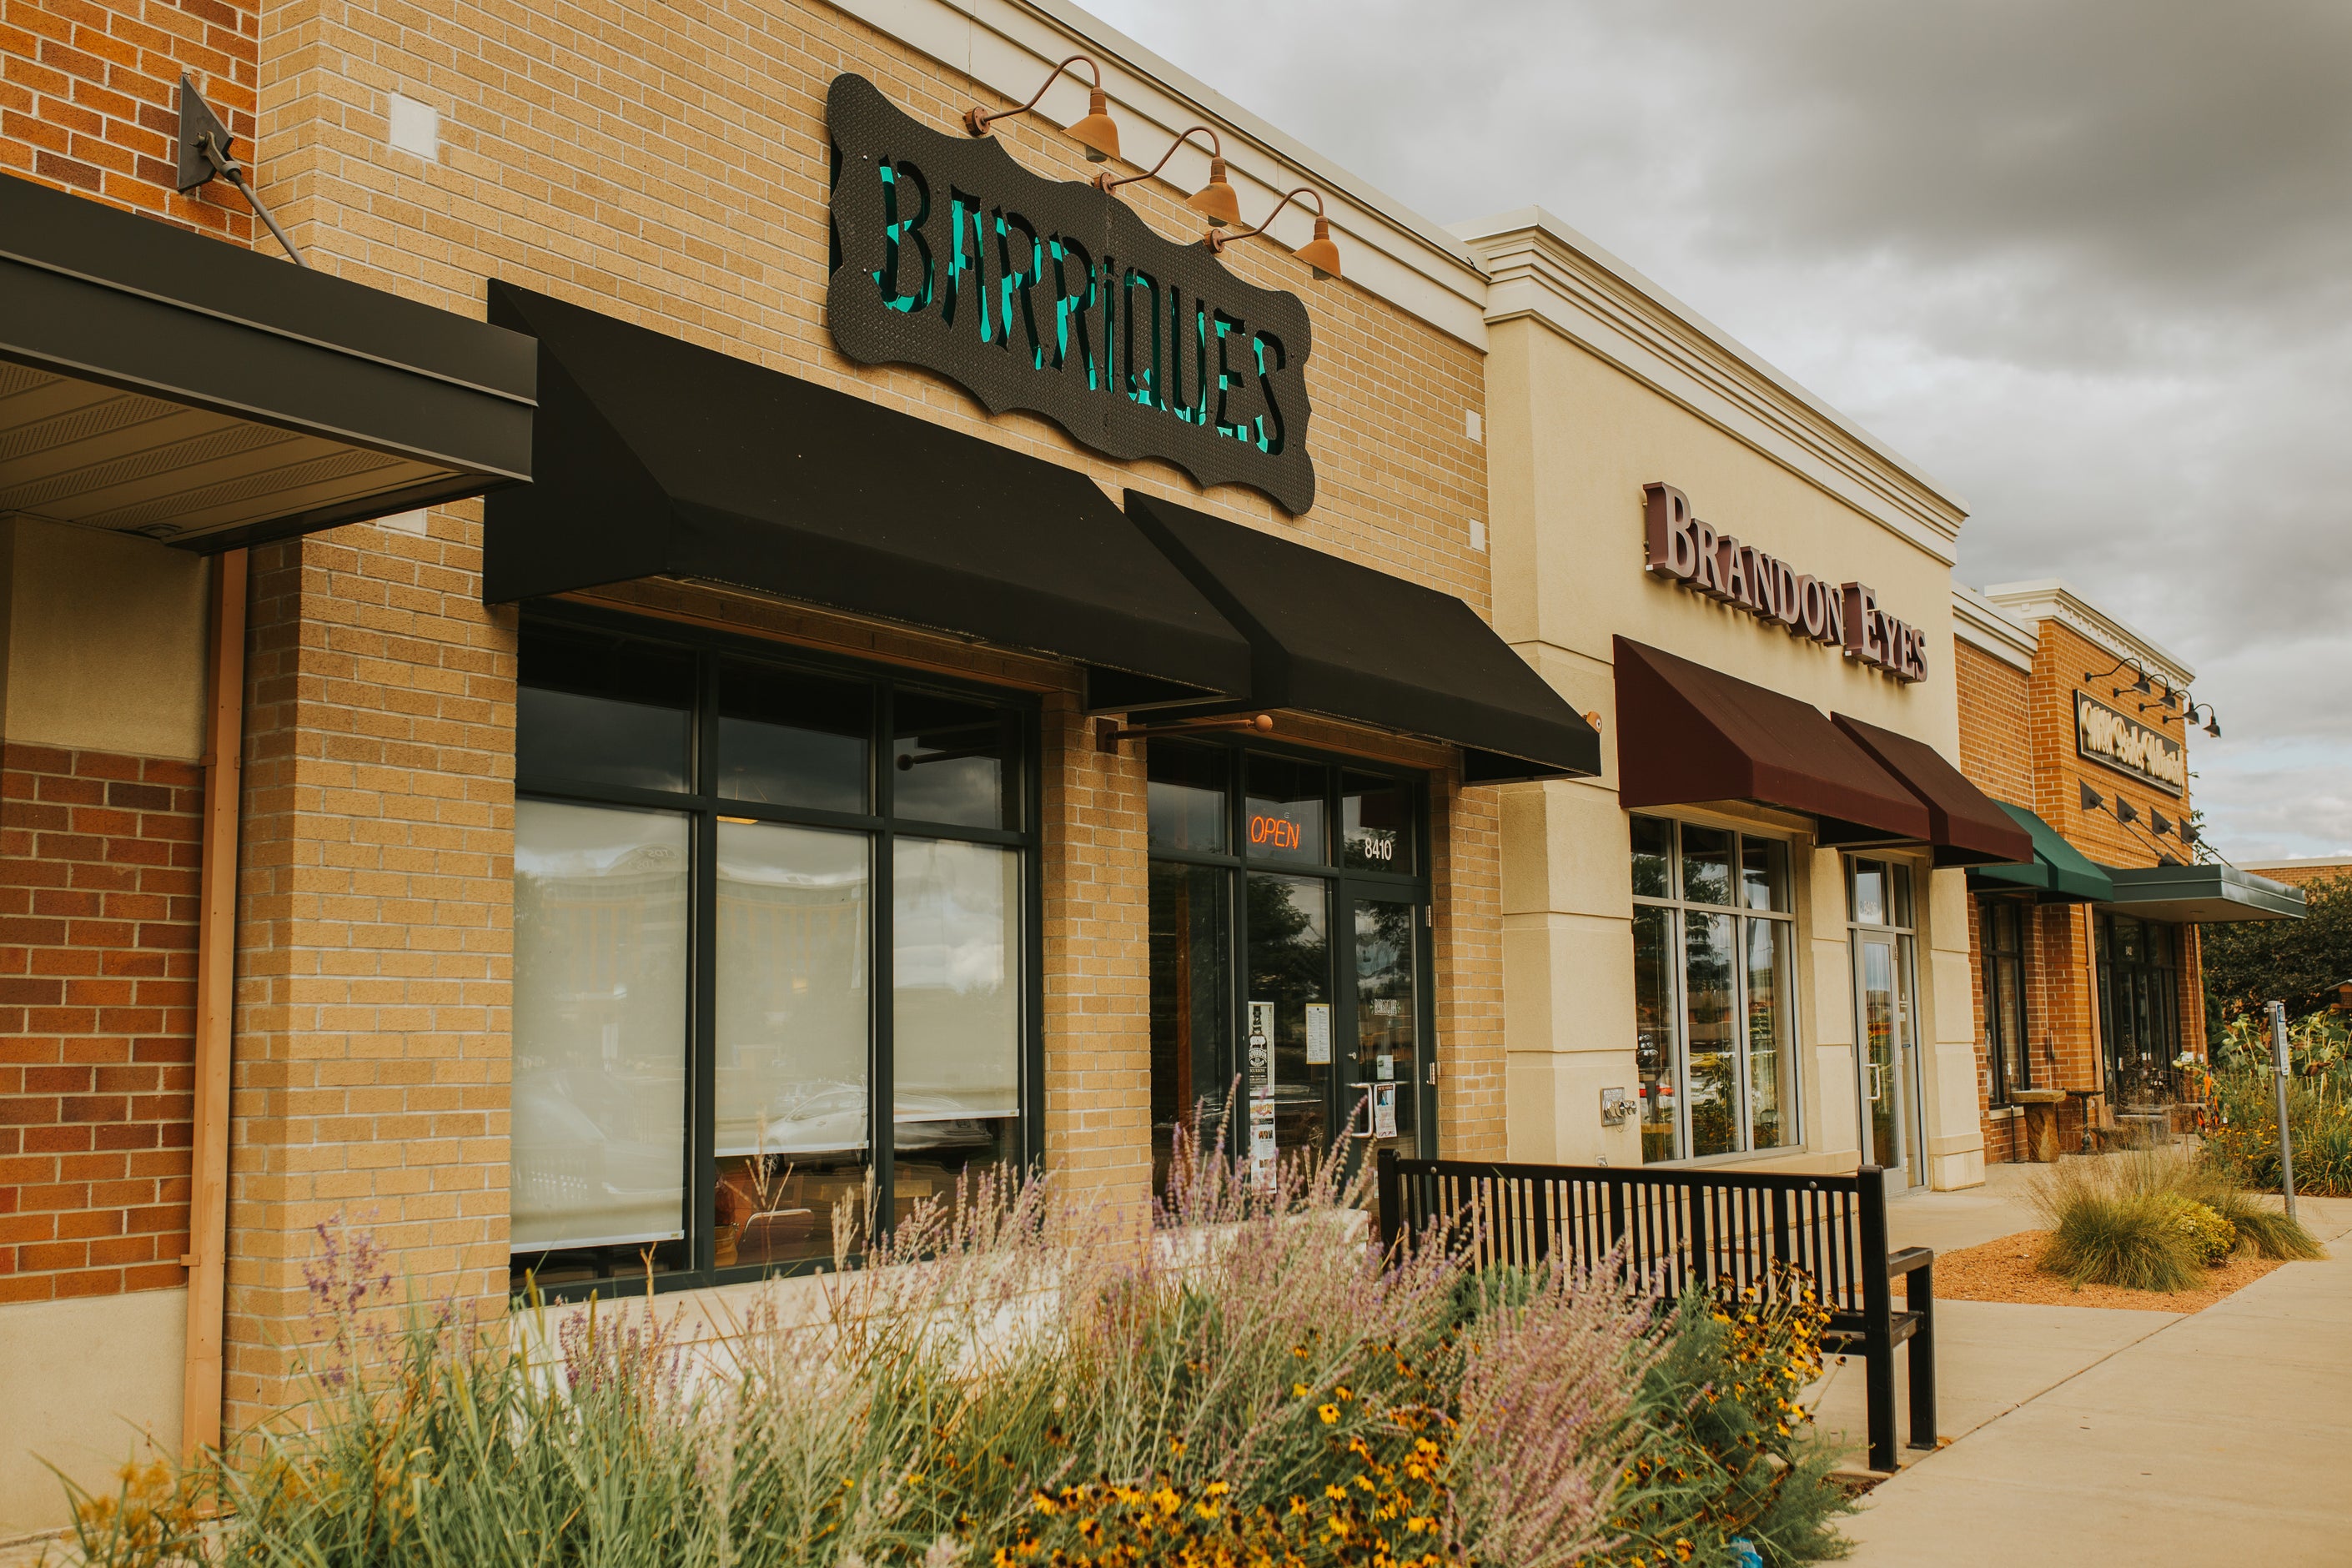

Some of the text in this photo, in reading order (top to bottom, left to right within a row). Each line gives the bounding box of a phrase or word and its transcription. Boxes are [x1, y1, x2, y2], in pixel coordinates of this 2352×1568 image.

[1643, 481, 1928, 683] BRANDON EYES
[1251, 816, 1300, 850] OPEN
[1364, 837, 1392, 860] 8410
